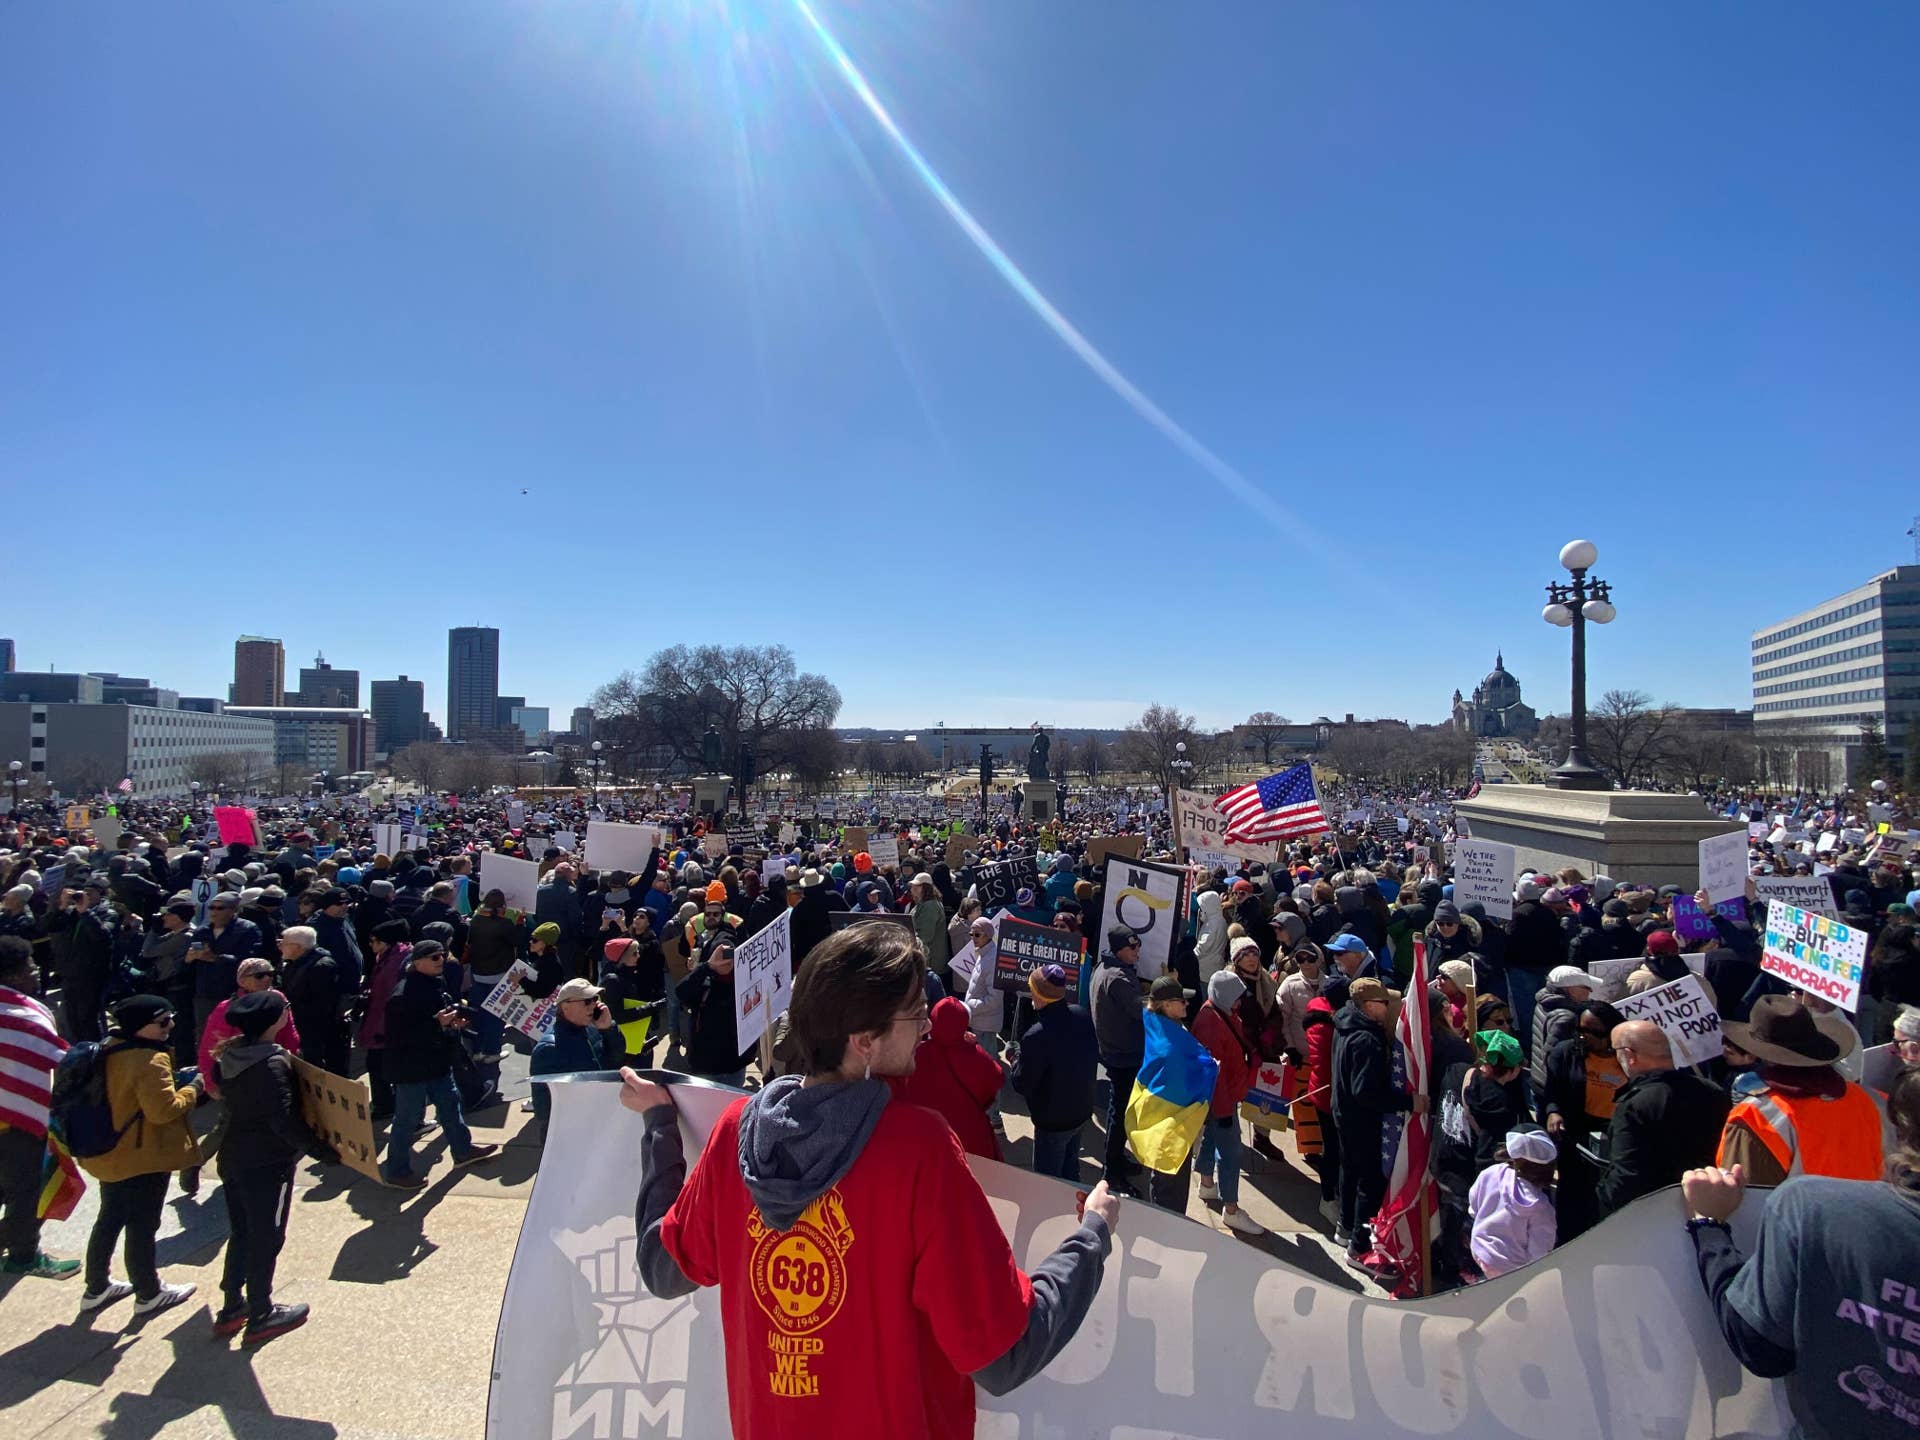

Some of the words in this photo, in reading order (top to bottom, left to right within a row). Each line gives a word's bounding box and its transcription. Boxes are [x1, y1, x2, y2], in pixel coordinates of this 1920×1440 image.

[977, 863, 1003, 881] THE
[980, 879, 1006, 906] IS
[1679, 903, 1738, 917] HADS
[1693, 918, 1718, 933] OF
[1785, 905, 1849, 943] RETIRED
[737, 930, 769, 968] ARREST
[771, 916, 786, 943] THE
[1001, 937, 1017, 952] ARE
[1019, 940, 1031, 956] WE
[1033, 943, 1058, 960] GREAT
[1060, 947, 1079, 965] YET?
[1766, 930, 1830, 971] WORKING
[1832, 958, 1863, 984] FOR
[1761, 951, 1851, 1003] DEMOCRACY
[1649, 983, 1689, 1007] THE
[1664, 997, 1702, 1023] NOT
[1679, 1012, 1719, 1040] POOR
[755, 1235, 779, 1297] INTERNATIONAL
[772, 1255, 825, 1297] 638
[773, 1304, 793, 1329] Since
[796, 1314, 821, 1329] 1946
[768, 1330, 824, 1352] UNITED
[775, 1352, 809, 1375] WE
[769, 1372, 819, 1395] WIN!
